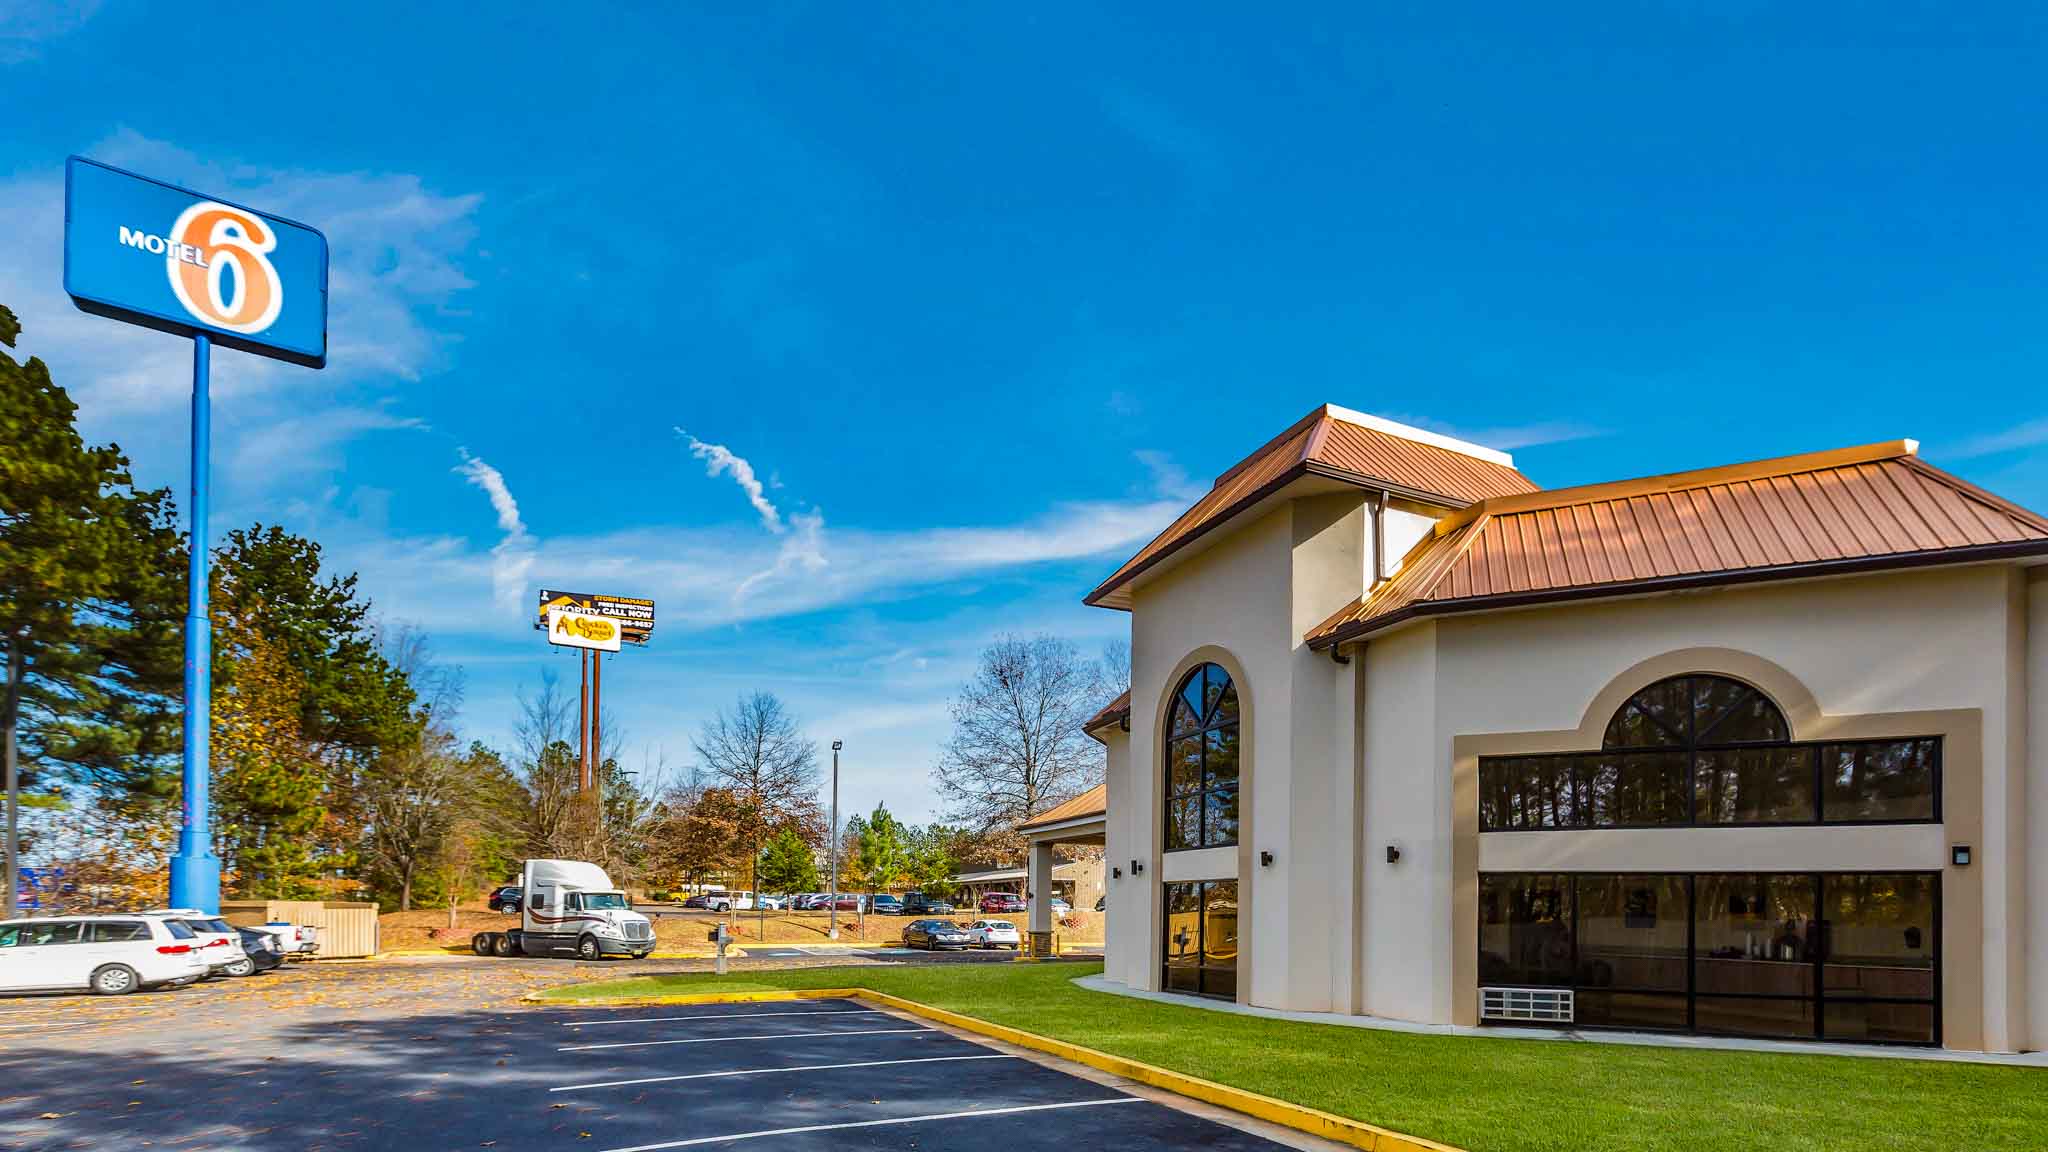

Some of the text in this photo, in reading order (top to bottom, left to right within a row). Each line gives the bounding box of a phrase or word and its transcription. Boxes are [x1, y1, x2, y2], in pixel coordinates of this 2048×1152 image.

[119, 201, 283, 334] MOTEL 6
[602, 607, 652, 619] CALL NOW
